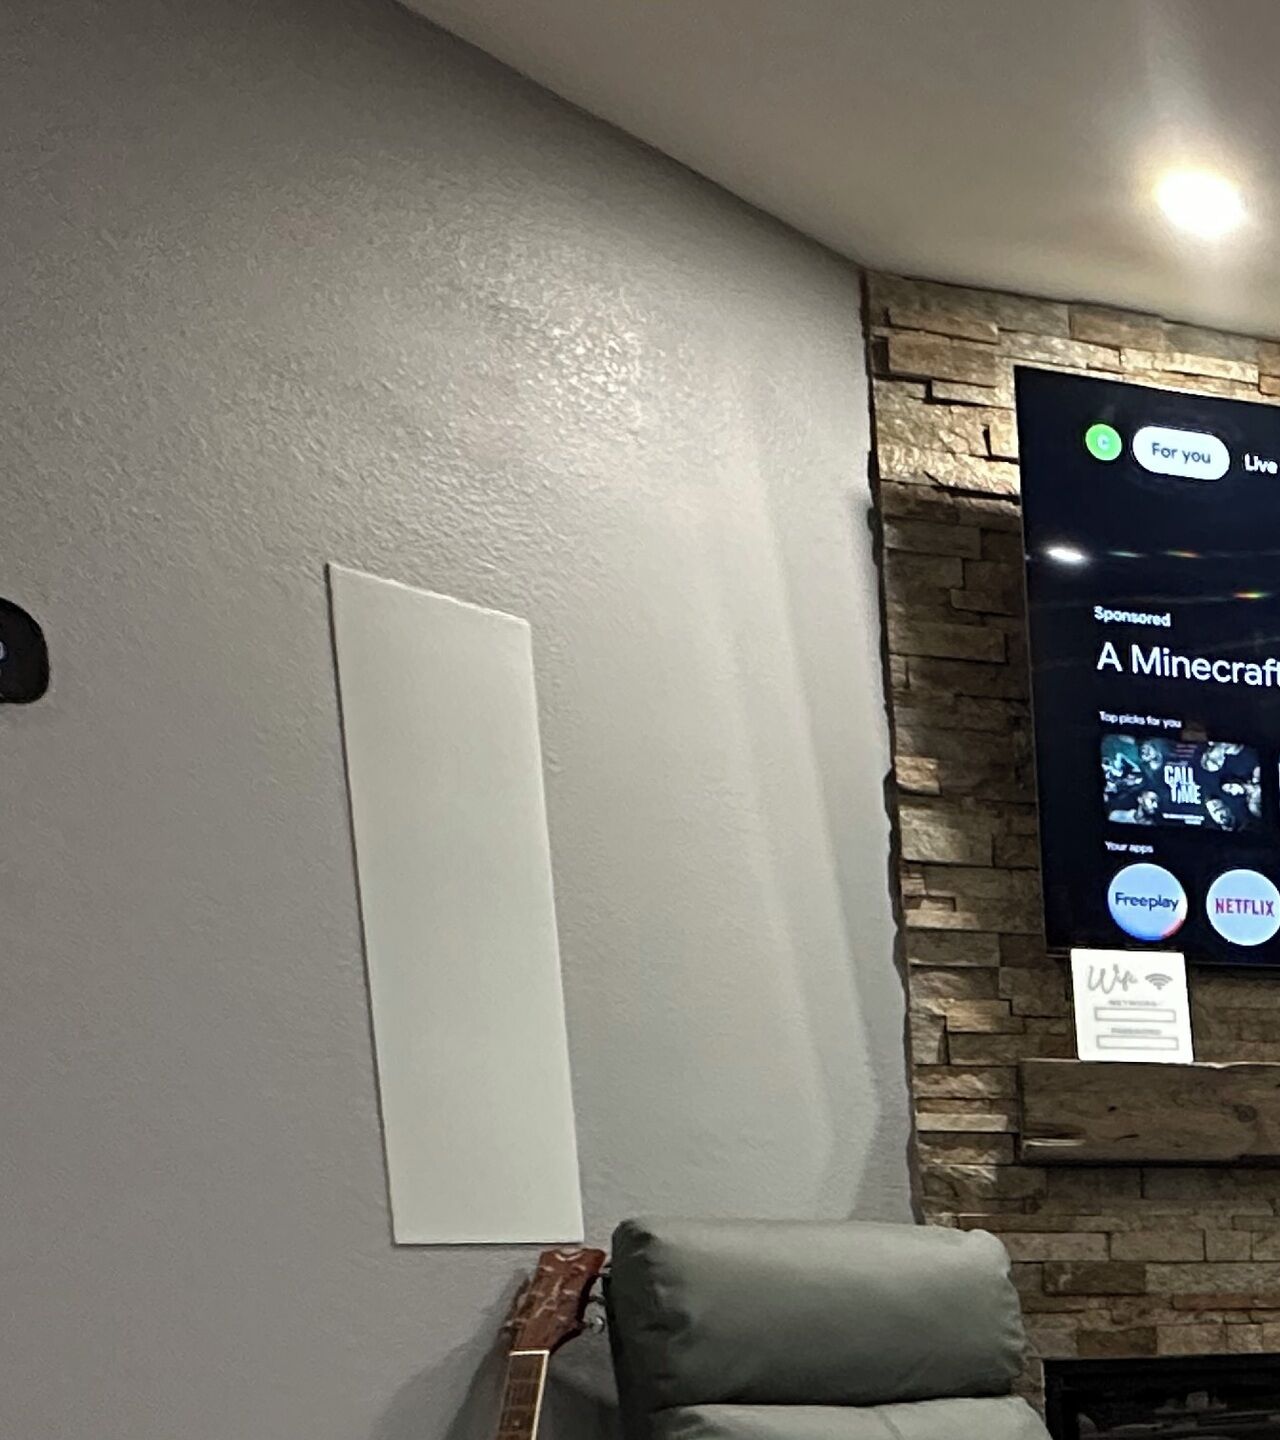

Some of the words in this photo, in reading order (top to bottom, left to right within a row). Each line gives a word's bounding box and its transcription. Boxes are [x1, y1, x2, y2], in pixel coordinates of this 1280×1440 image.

[1151, 443, 1178, 459] For
[1182, 451, 1212, 465] you
[1244, 453, 1278, 474] Live
[1094, 606, 1172, 627] Sponsored
[1096, 641, 1123, 672] A
[1099, 711, 1118, 724] Top
[1119, 714, 1145, 726] picks
[1147, 716, 1160, 726] for
[1163, 719, 1182, 729] you
[1164, 765, 1195, 785] CALL
[1105, 841, 1127, 851] Your
[1129, 844, 1154, 854] apps
[1115, 892, 1179, 911] Freeplay
[1215, 898, 1275, 917] NETFLIX
